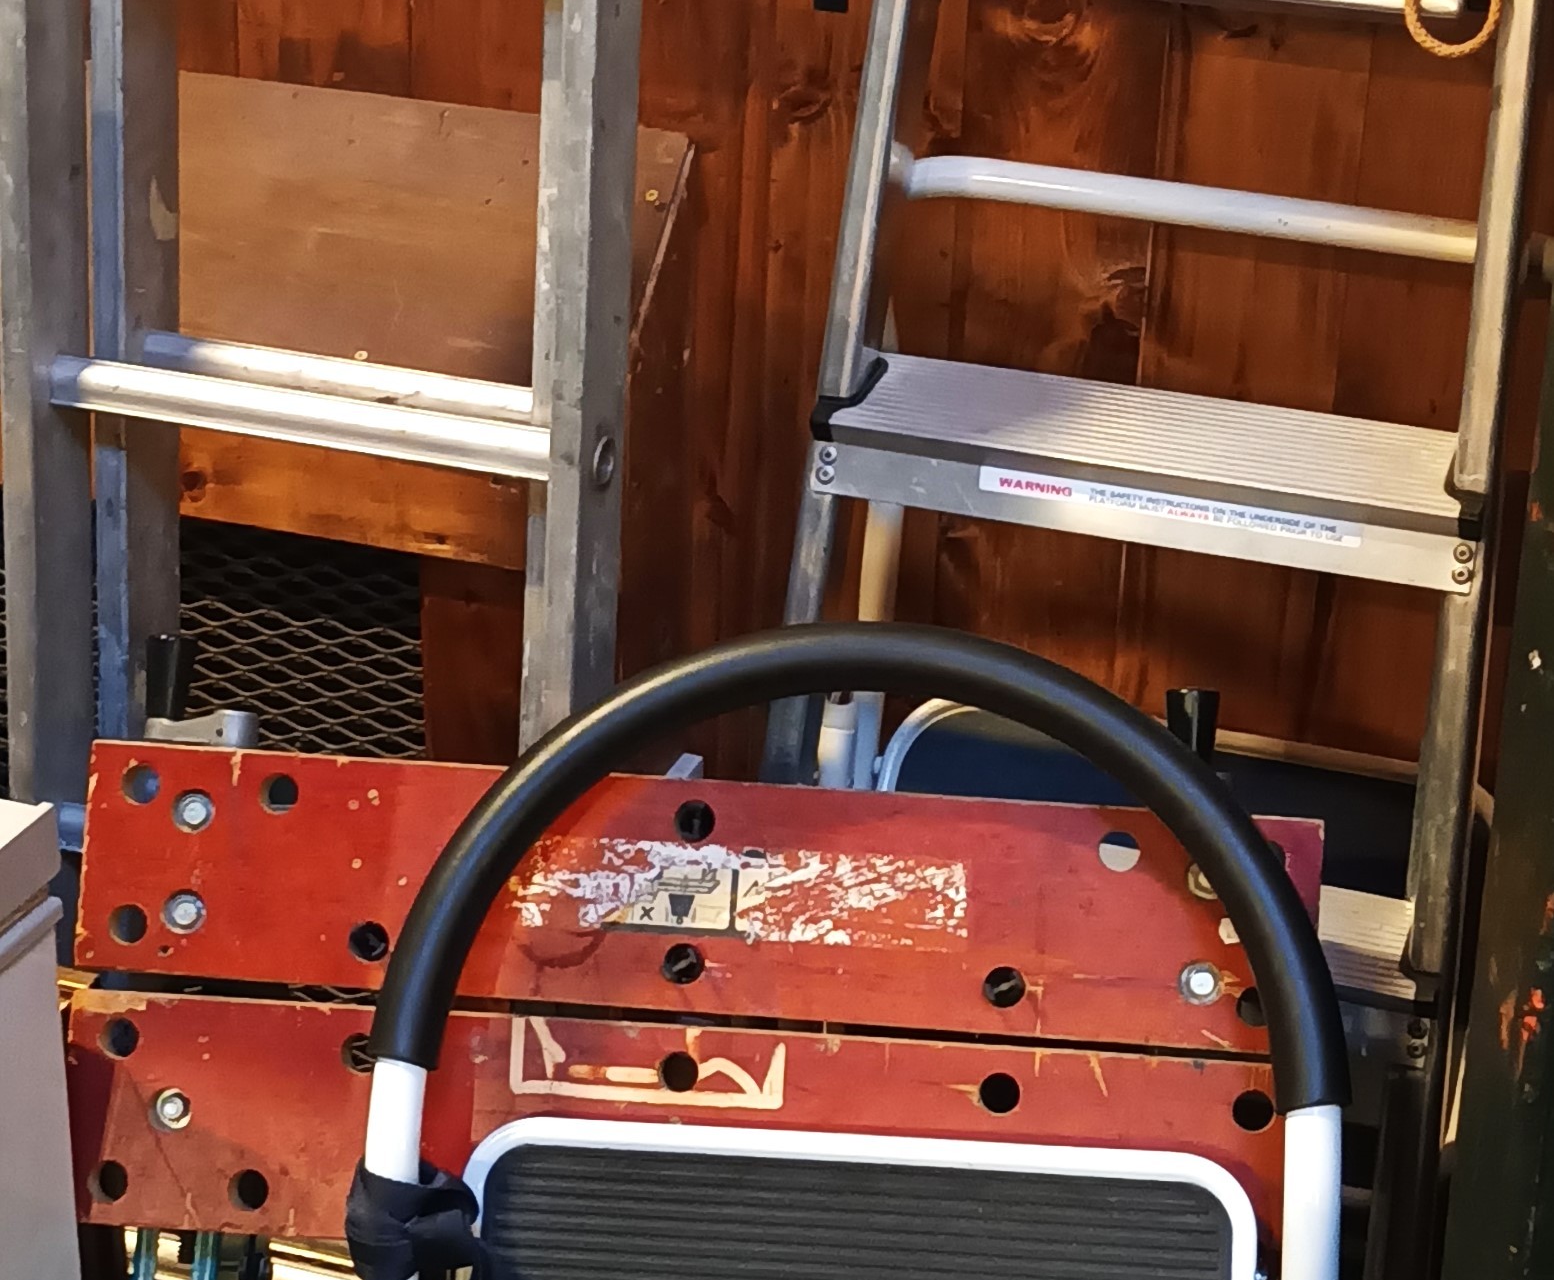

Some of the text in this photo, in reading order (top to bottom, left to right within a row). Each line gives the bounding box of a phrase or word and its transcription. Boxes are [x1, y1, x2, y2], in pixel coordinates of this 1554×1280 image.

[999, 477, 1073, 497] WARNING
[1089, 495, 1136, 509] PLATFORM
[1167, 507, 1210, 521] ALWAYS
[1227, 516, 1278, 532] FOLLOWED
[1310, 529, 1323, 539] TO
[1090, 488, 1106, 498] THE
[1110, 490, 1143, 503] SAFETY
[1229, 508, 1246, 519] THE
[1249, 511, 1300, 528] UNDERSIDE
[1303, 520, 1316, 529] OF
[1320, 523, 1337, 534] THE
